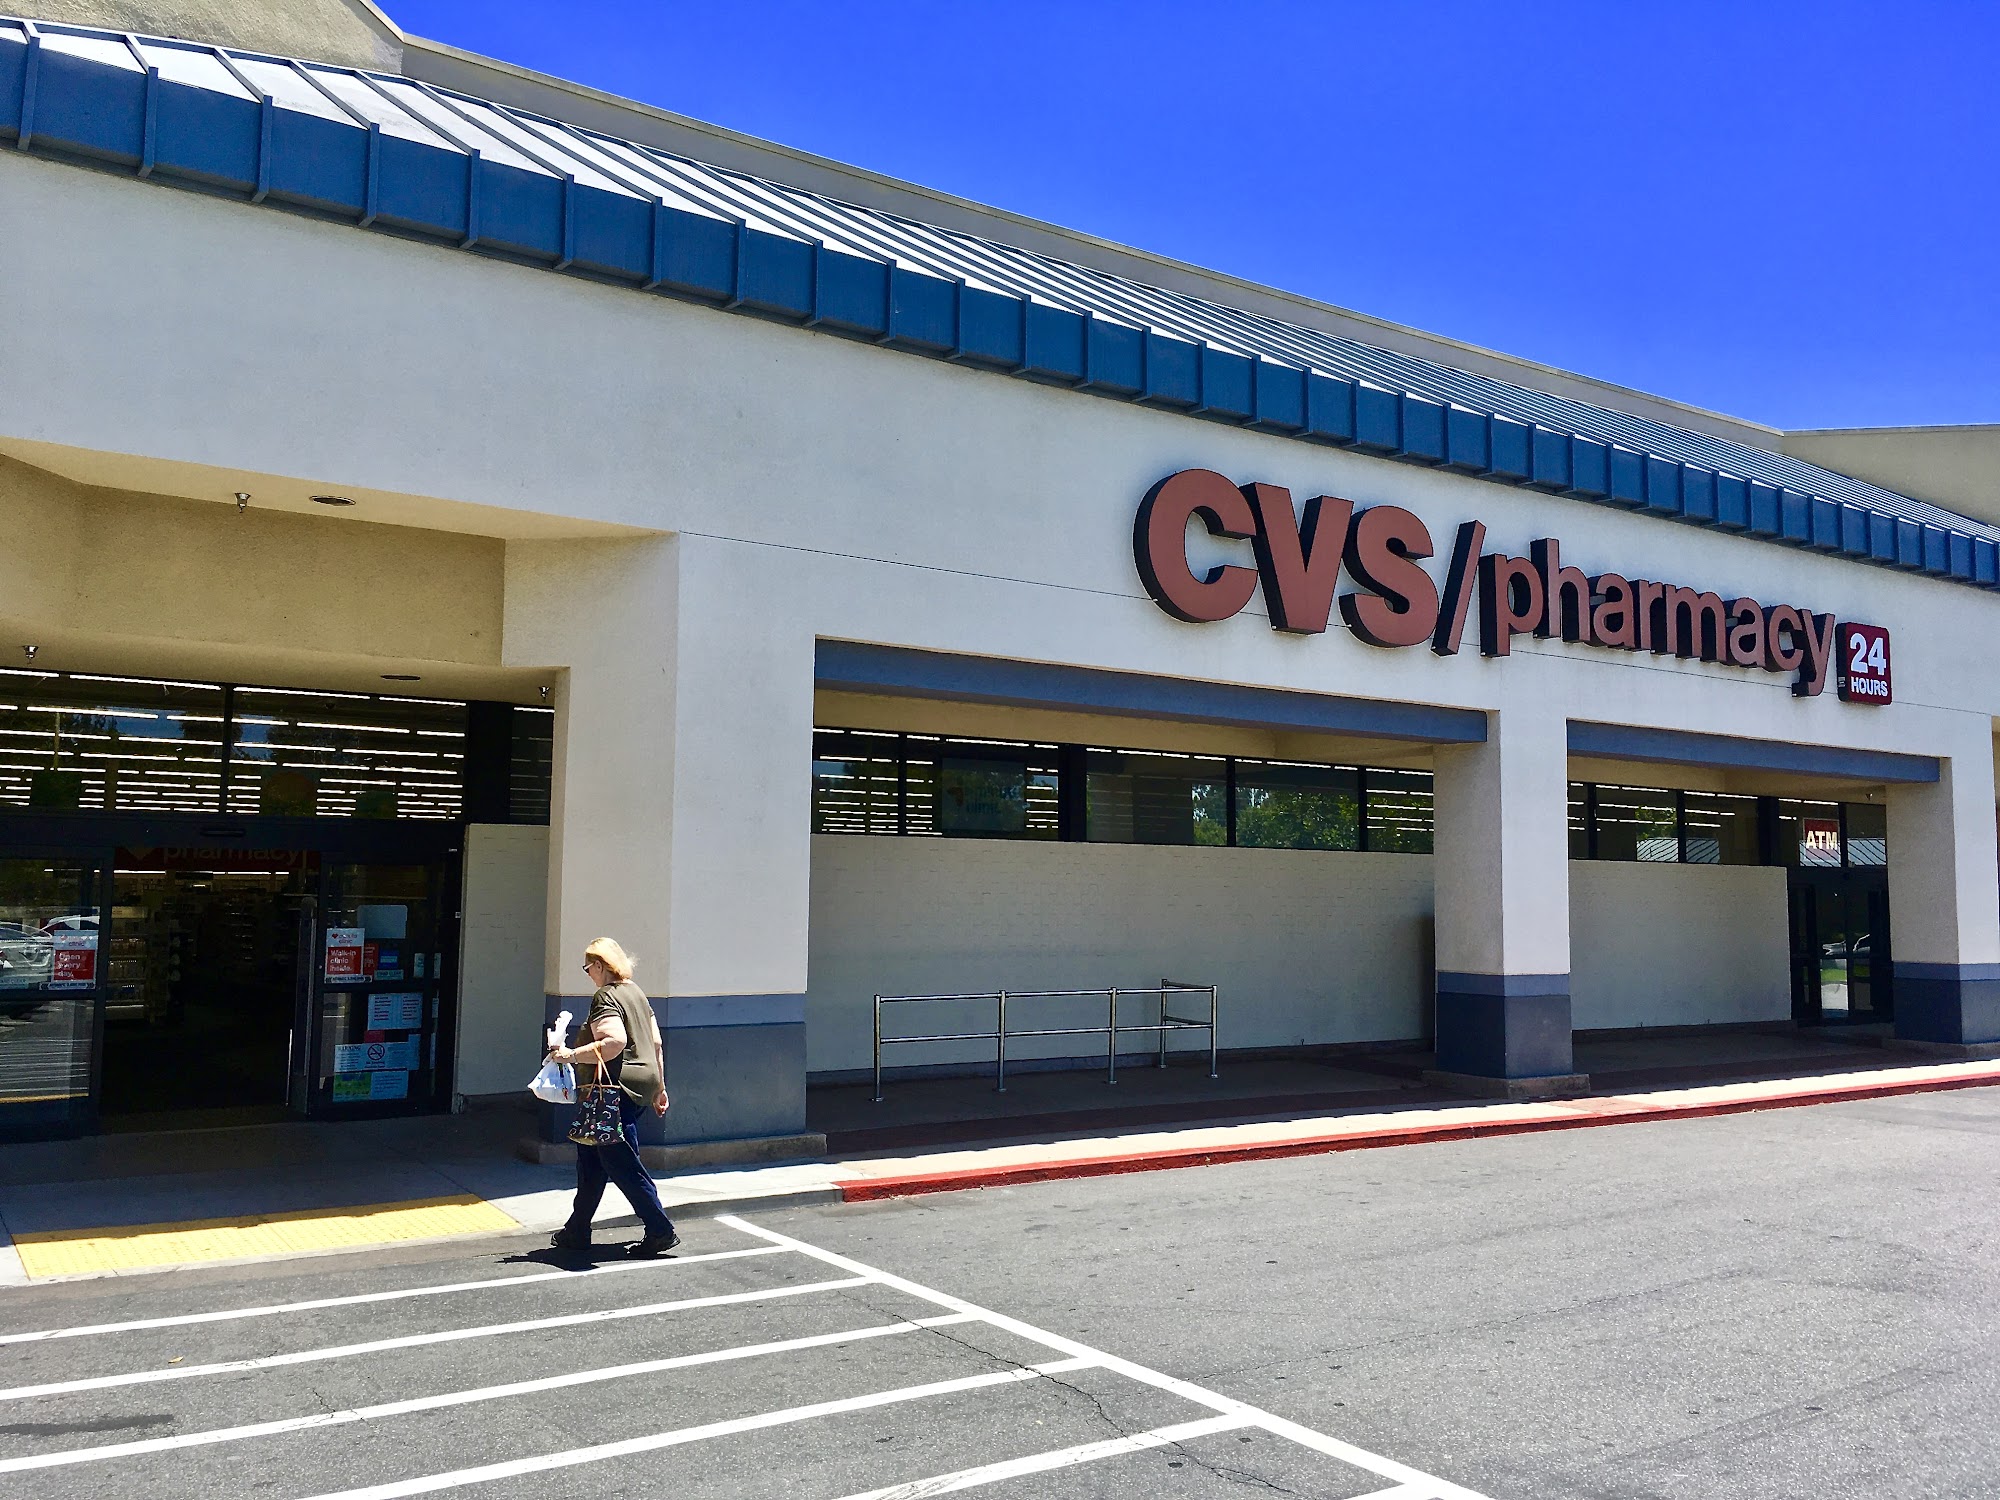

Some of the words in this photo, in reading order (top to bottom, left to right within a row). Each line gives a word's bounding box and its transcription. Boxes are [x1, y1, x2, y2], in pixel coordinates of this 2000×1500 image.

[1849, 632, 1887, 676] 24
[1850, 676, 1888, 697] HOURS
[1806, 831, 1838, 850] ATM
[58, 952, 81, 962] Open
[330, 949, 357, 957] Walk-in
[58, 961, 81, 969] every
